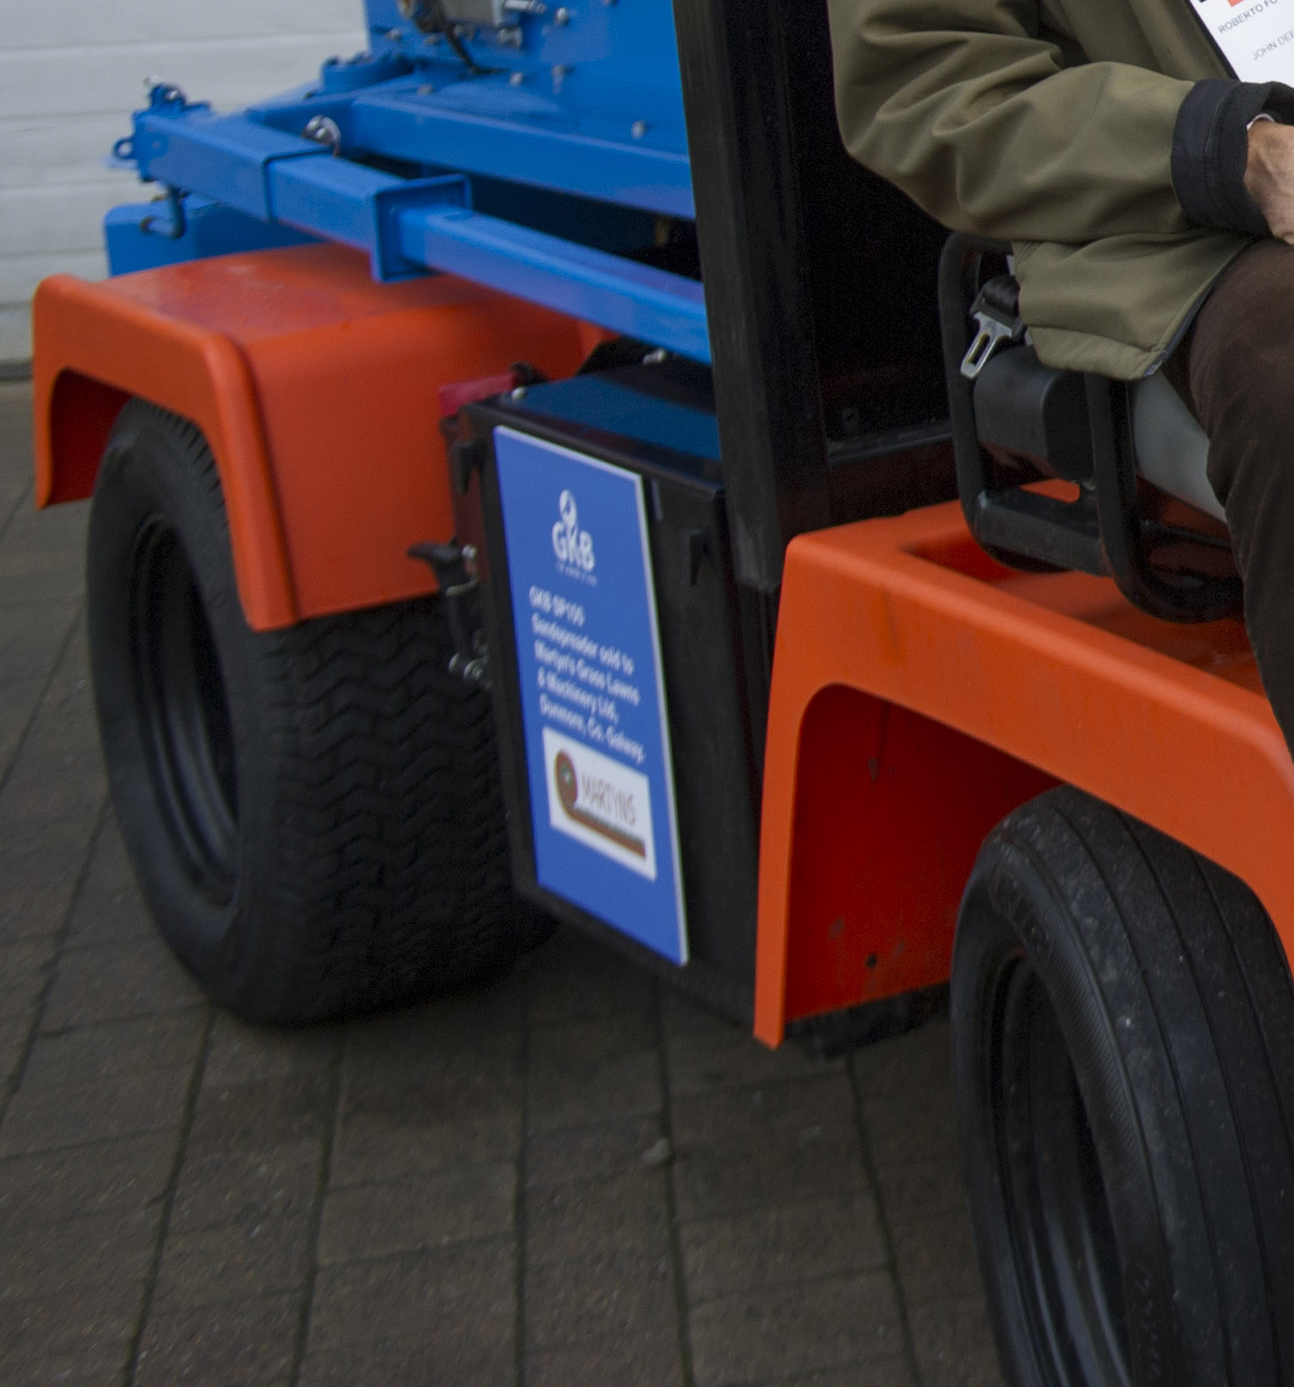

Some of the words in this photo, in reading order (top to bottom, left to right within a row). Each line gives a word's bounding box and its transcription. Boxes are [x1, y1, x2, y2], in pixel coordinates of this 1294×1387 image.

[1218, 4, 1263, 33] ROBERTO
[1253, 42, 1277, 60] JOHN
[552, 521, 595, 572] GKB
[581, 772, 637, 826] MARTYNS
